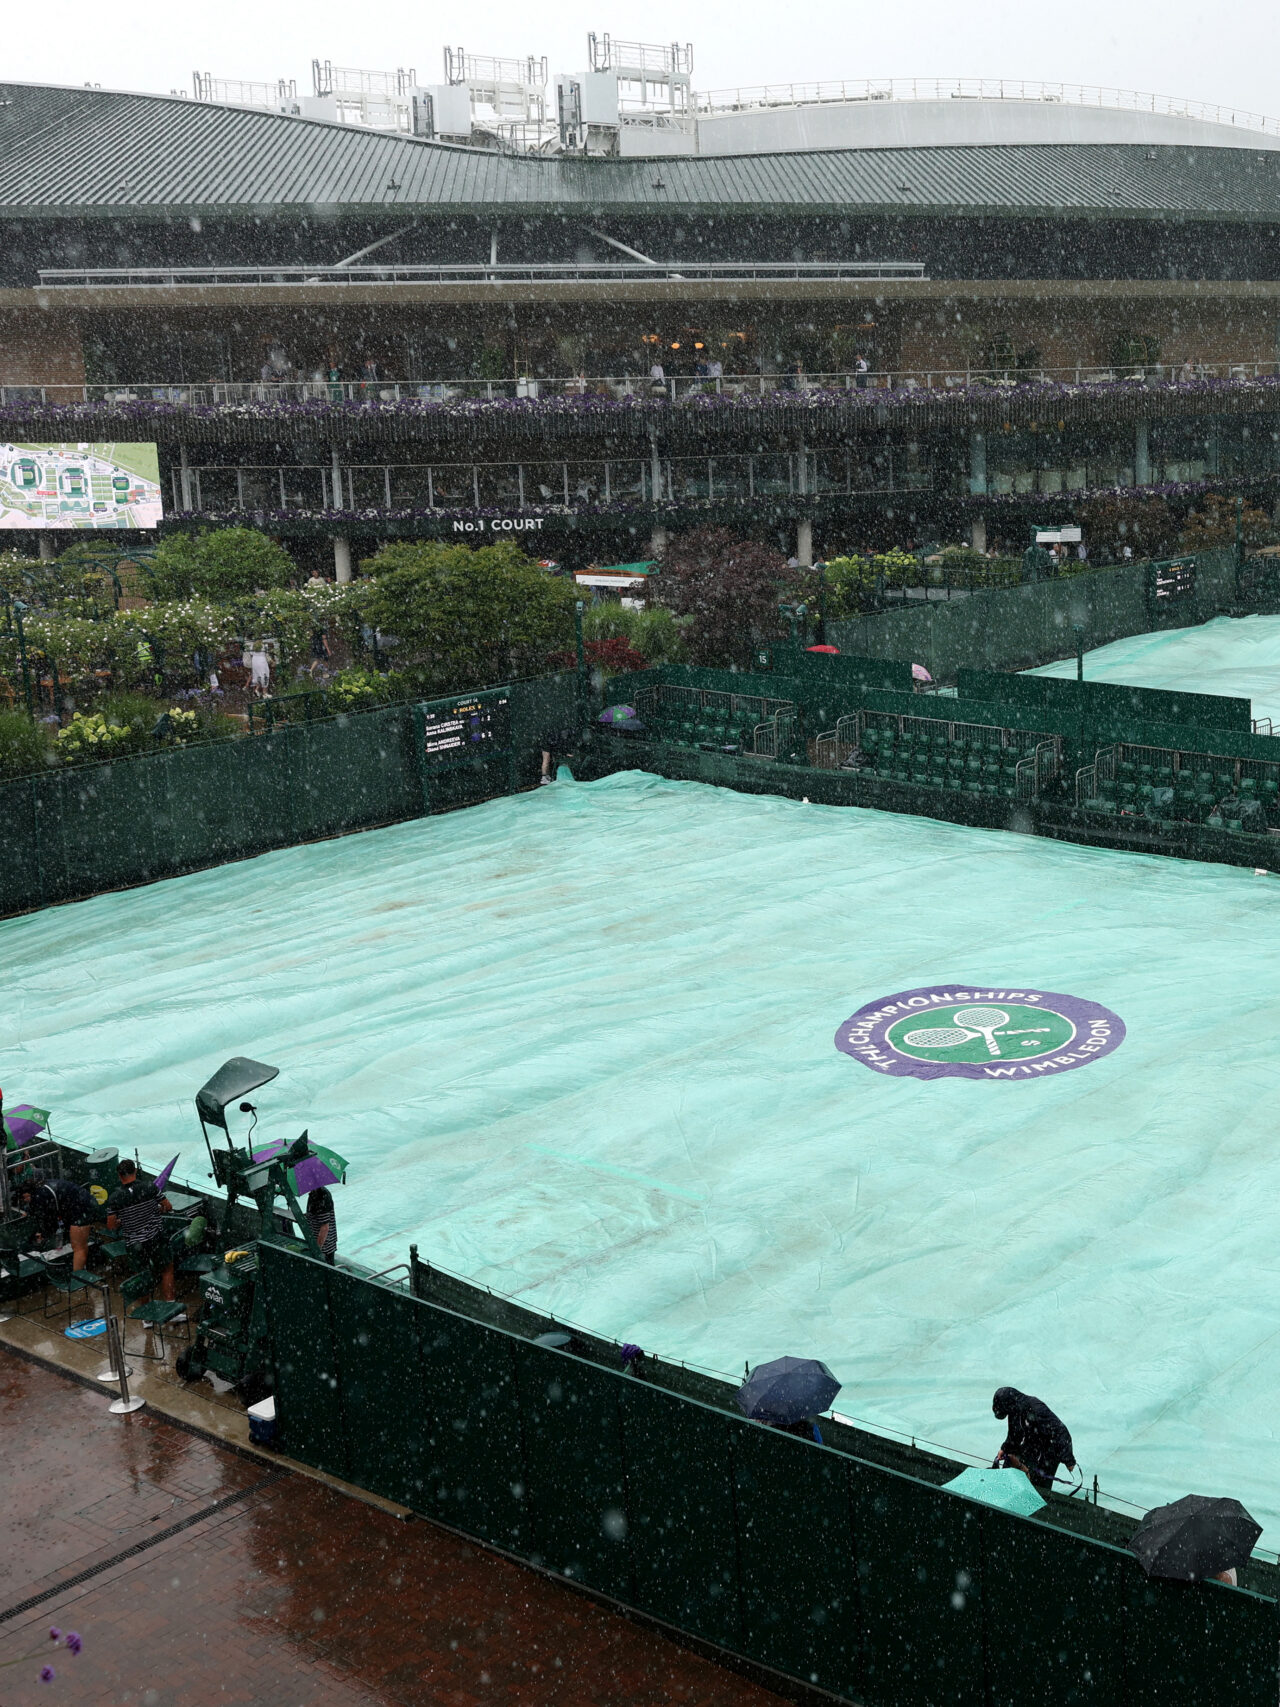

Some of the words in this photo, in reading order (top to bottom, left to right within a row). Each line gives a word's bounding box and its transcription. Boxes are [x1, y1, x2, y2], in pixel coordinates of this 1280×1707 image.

[453, 520, 484, 532] No.1
[491, 518, 544, 531] COURT
[759, 655, 767, 664] 15
[848, 991, 1045, 1045] CHAMPIONSHIPS
[983, 1019, 1112, 1077] WIMBLEDON
